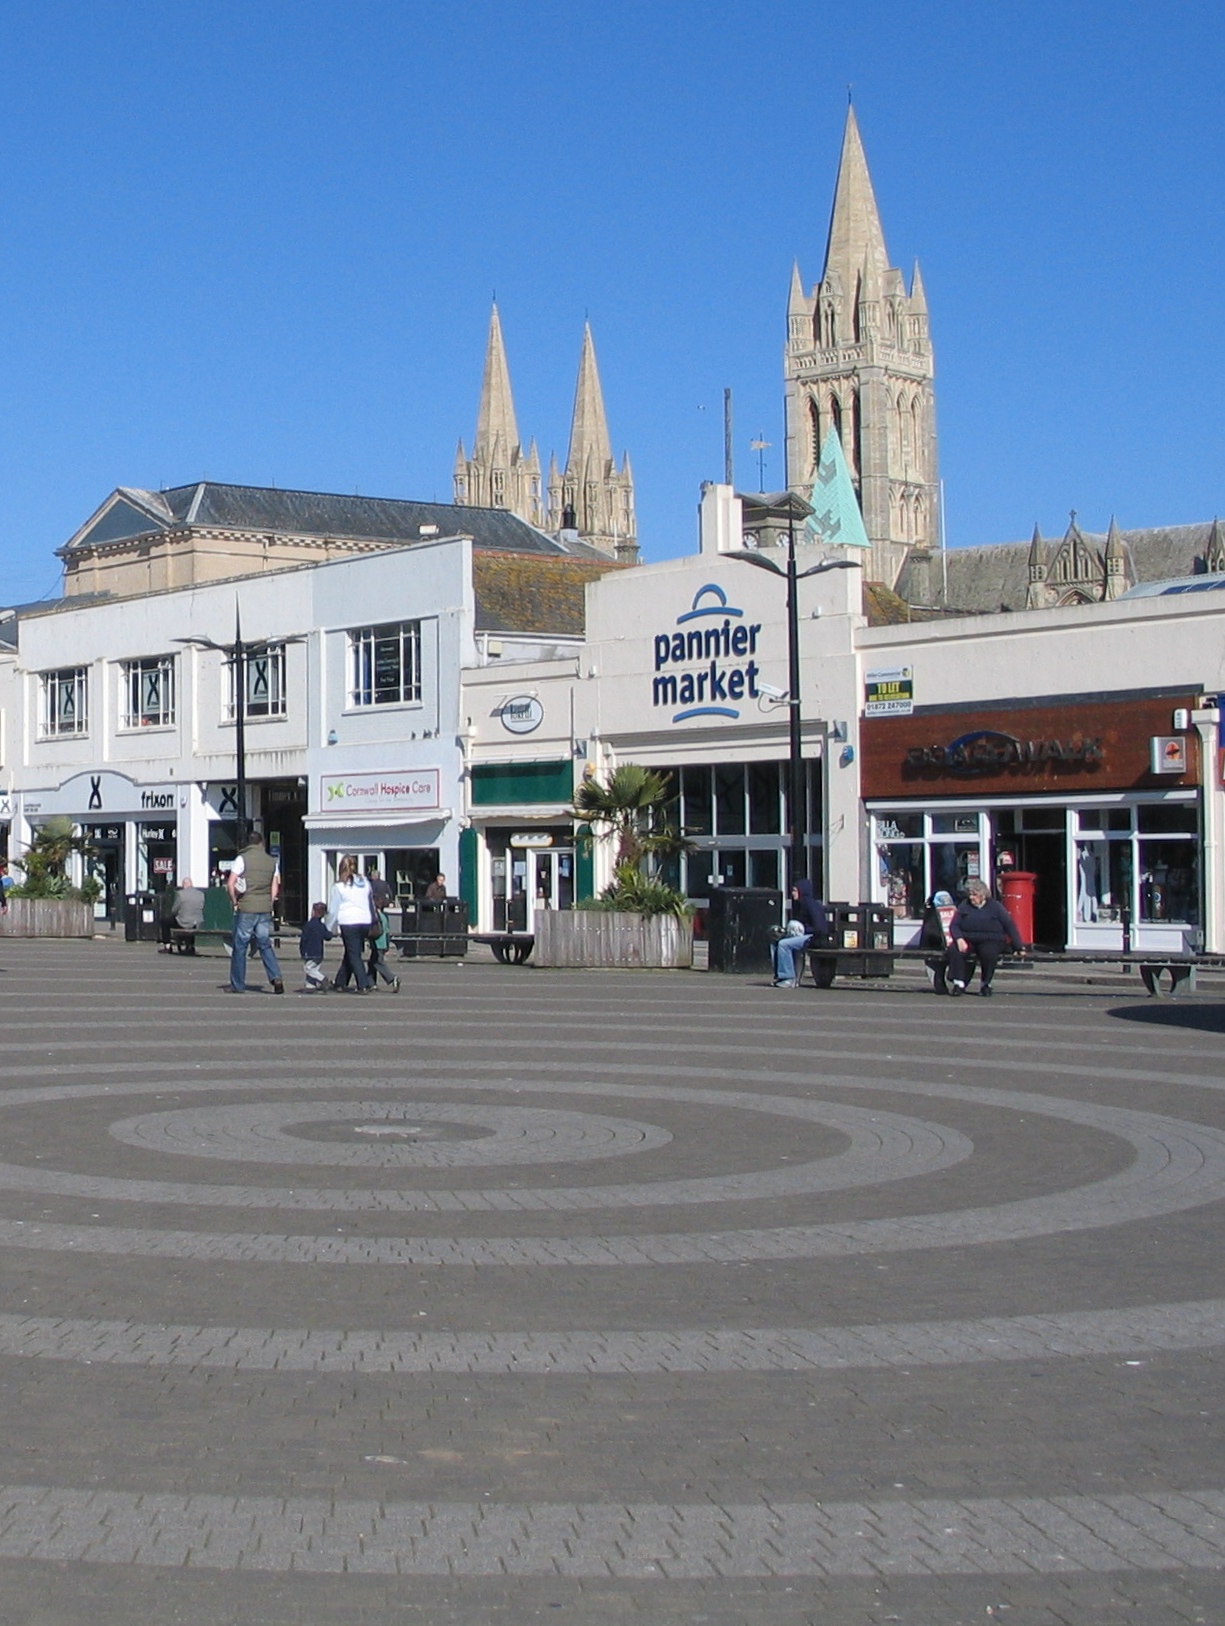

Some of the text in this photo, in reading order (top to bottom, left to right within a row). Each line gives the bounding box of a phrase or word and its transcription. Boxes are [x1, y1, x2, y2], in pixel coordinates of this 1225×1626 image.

[654, 619, 762, 672] pannier
[653, 660, 759, 707] market
[877, 681, 900, 694] TO LET
[345, 780, 431, 797] Cornwall Hospice Care
[141, 790, 174, 809] frixon
[155, 860, 173, 871] SALE
